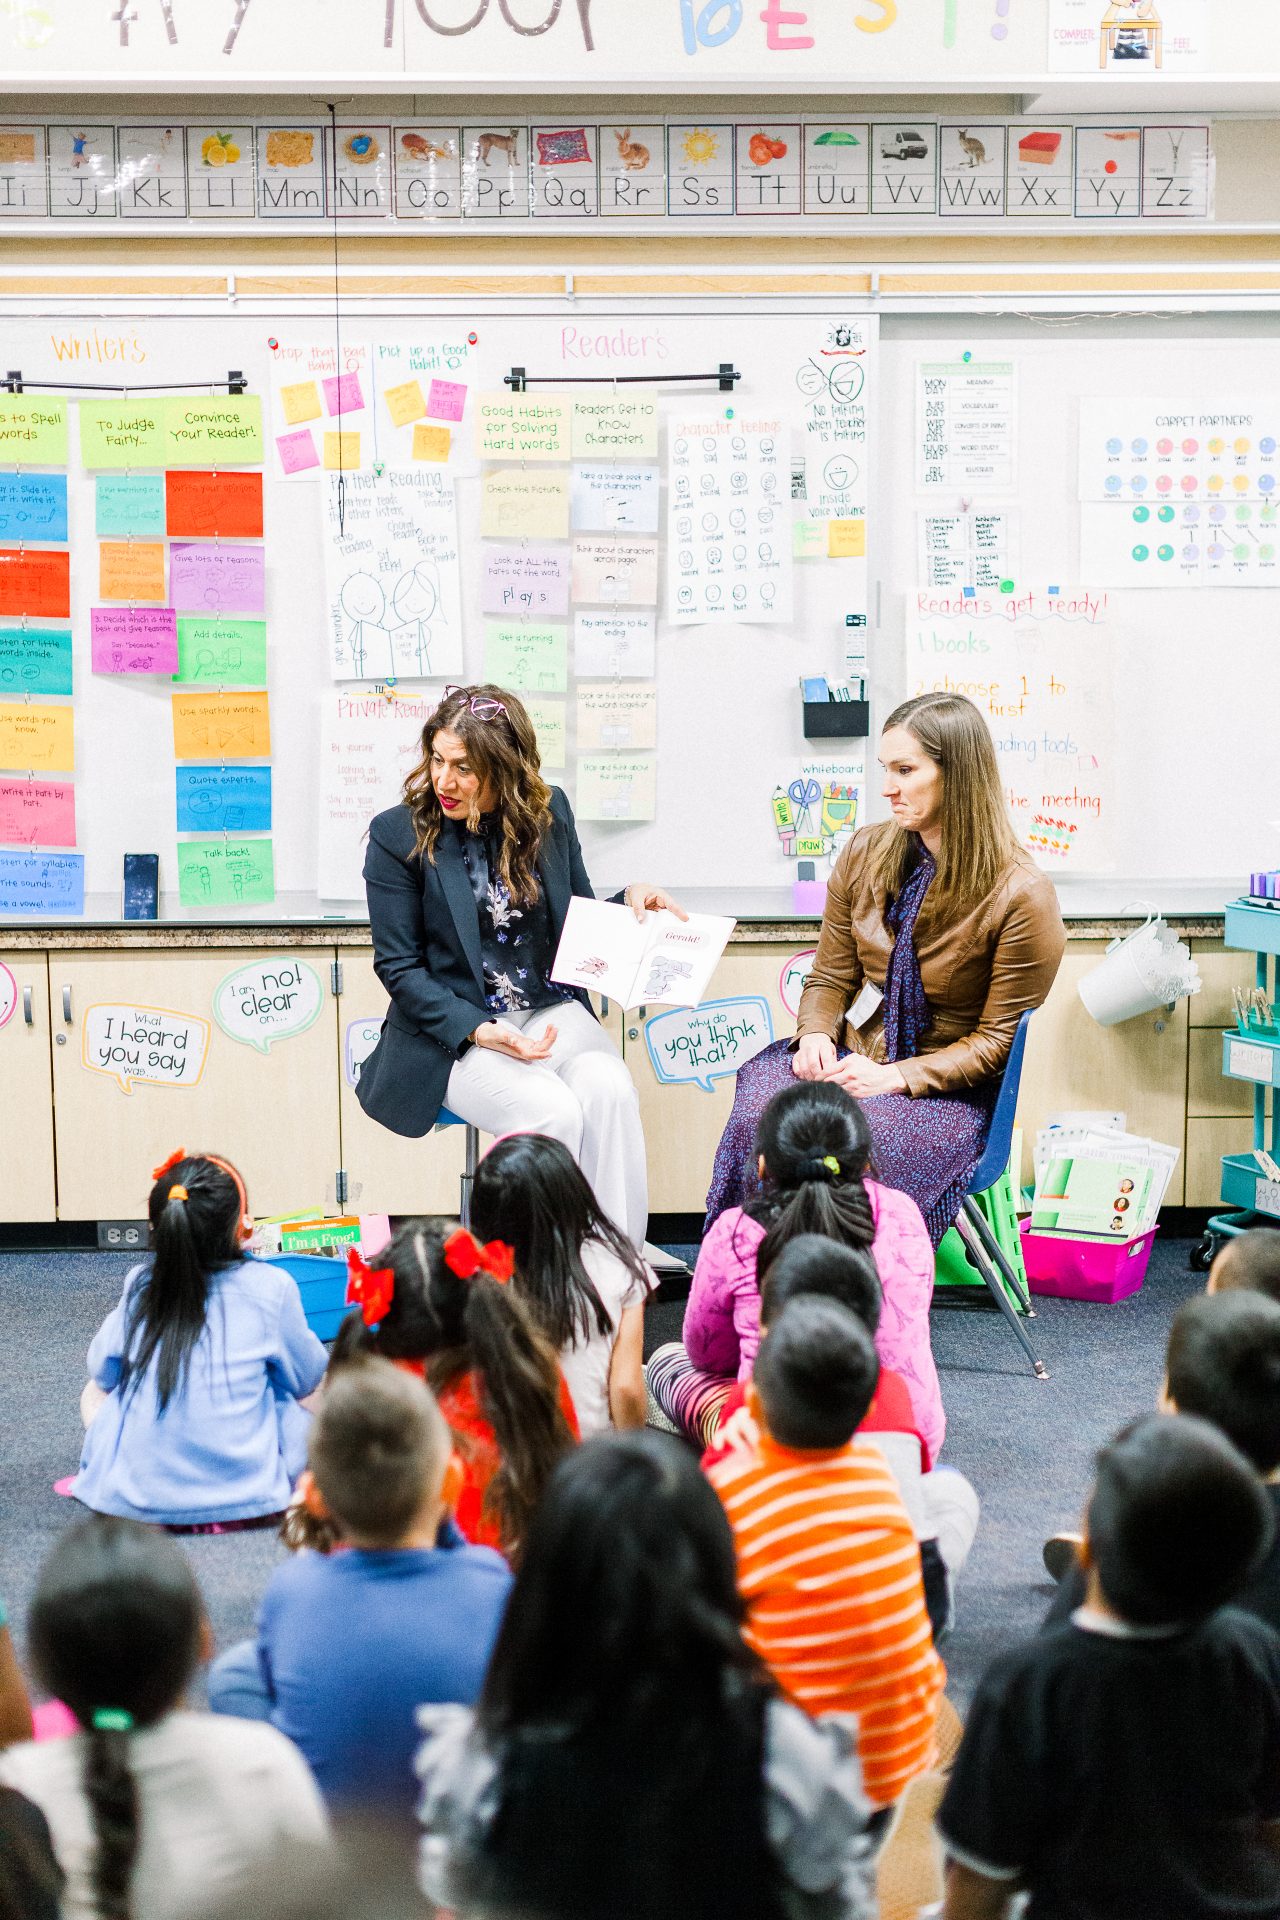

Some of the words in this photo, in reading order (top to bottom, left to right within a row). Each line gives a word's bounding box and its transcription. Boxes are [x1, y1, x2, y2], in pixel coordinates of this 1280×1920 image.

[1053, 29, 1095, 40] COMPLETE
[66, 177, 98, 214] Jj
[133, 178, 172, 207] Kk
[263, 179, 319, 207] Mm
[340, 178, 380, 207] Nn
[408, 178, 449, 208] Oo
[477, 178, 514, 214] Pp
[543, 178, 593, 214] Qq
[614, 177, 650, 207] Rr
[682, 176, 719, 206] Ss
[751, 175, 787, 205] Tt
[817, 175, 857, 205] Uu
[885, 175, 924, 204] Vv
[943, 177, 1001, 206] Ww
[1021, 177, 1057, 206] Xx
[1089, 178, 1125, 214] Yy
[1156, 177, 1193, 207] Zz
[561, 327, 670, 359] Reader's
[343, 346, 366, 358] Bad
[379, 345, 401, 358] Pick
[409, 347, 424, 359] up
[442, 344, 468, 357] Good
[924, 379, 946, 387] MON
[482, 405, 513, 417] Good
[519, 405, 562, 417] Habits
[575, 403, 614, 415] Readers
[619, 404, 636, 415] Get
[640, 404, 654, 415] to
[813, 404, 827, 417] No
[831, 403, 865, 420] talking
[925, 409, 944, 417] DAY
[13, 412, 26, 424] to
[31, 412, 61, 425] Spell
[184, 411, 240, 424] Convince
[1156, 416, 1197, 427] CARPET
[1200, 415, 1253, 427] PARTNERS
[96, 420, 113, 432] To
[117, 418, 155, 437] Judge
[486, 422, 508, 435] for
[511, 422, 558, 436] Solving
[598, 420, 631, 431] Know
[170, 429, 203, 442] Your
[207, 426, 257, 440] Reader!
[585, 432, 643, 445] Characters
[820, 430, 829, 442] is
[833, 429, 865, 443] talking
[483, 439, 514, 451] Hard
[330, 473, 377, 490] Prtner
[389, 469, 443, 493] Reading
[487, 484, 511, 494] Check
[514, 484, 529, 494] the
[834, 503, 865, 517] volume
[494, 556, 512, 566] Look
[526, 557, 541, 567] ALL
[543, 558, 558, 567] the
[524, 567, 539, 577] the
[1004, 591, 1036, 622] get
[1048, 592, 1108, 624] ready!
[194, 630, 210, 640] Add
[499, 633, 513, 642] Get
[525, 634, 553, 645] running
[932, 630, 992, 654] books
[23, 638, 35, 649] for
[38, 638, 60, 649] little
[26, 649, 53, 659] inside.
[933, 674, 1000, 697] choose
[1047, 671, 1069, 697] to
[338, 698, 390, 719] Private
[987, 697, 1027, 718] first
[997, 733, 1038, 763] ading
[1043, 731, 1079, 755] tools
[802, 763, 864, 775] whiteboard
[189, 775, 218, 785] Quote
[221, 775, 256, 786] experts.
[1, 787, 24, 796] Write
[55, 789, 64, 800] by
[1041, 785, 1102, 818] meeting
[799, 839, 821, 852] Draw
[202, 848, 223, 859] Talk
[225, 848, 251, 858] back!
[665, 931, 702, 945] Gerald!
[230, 985, 237, 997] I
[238, 985, 257, 996] am
[261, 962, 304, 992] not
[240, 988, 300, 1018] clear
[134, 1011, 162, 1027] What
[713, 1013, 727, 1025] do
[104, 1017, 114, 1040] I
[120, 1020, 189, 1051] heard
[664, 1032, 701, 1060] you
[707, 1018, 757, 1044] think
[689, 1039, 739, 1067] that?
[99, 1046, 141, 1069] you
[148, 1050, 187, 1078] say
[288, 1236, 308, 1251] I'm
[311, 1237, 319, 1247] a
[321, 1230, 355, 1246] Frog!
